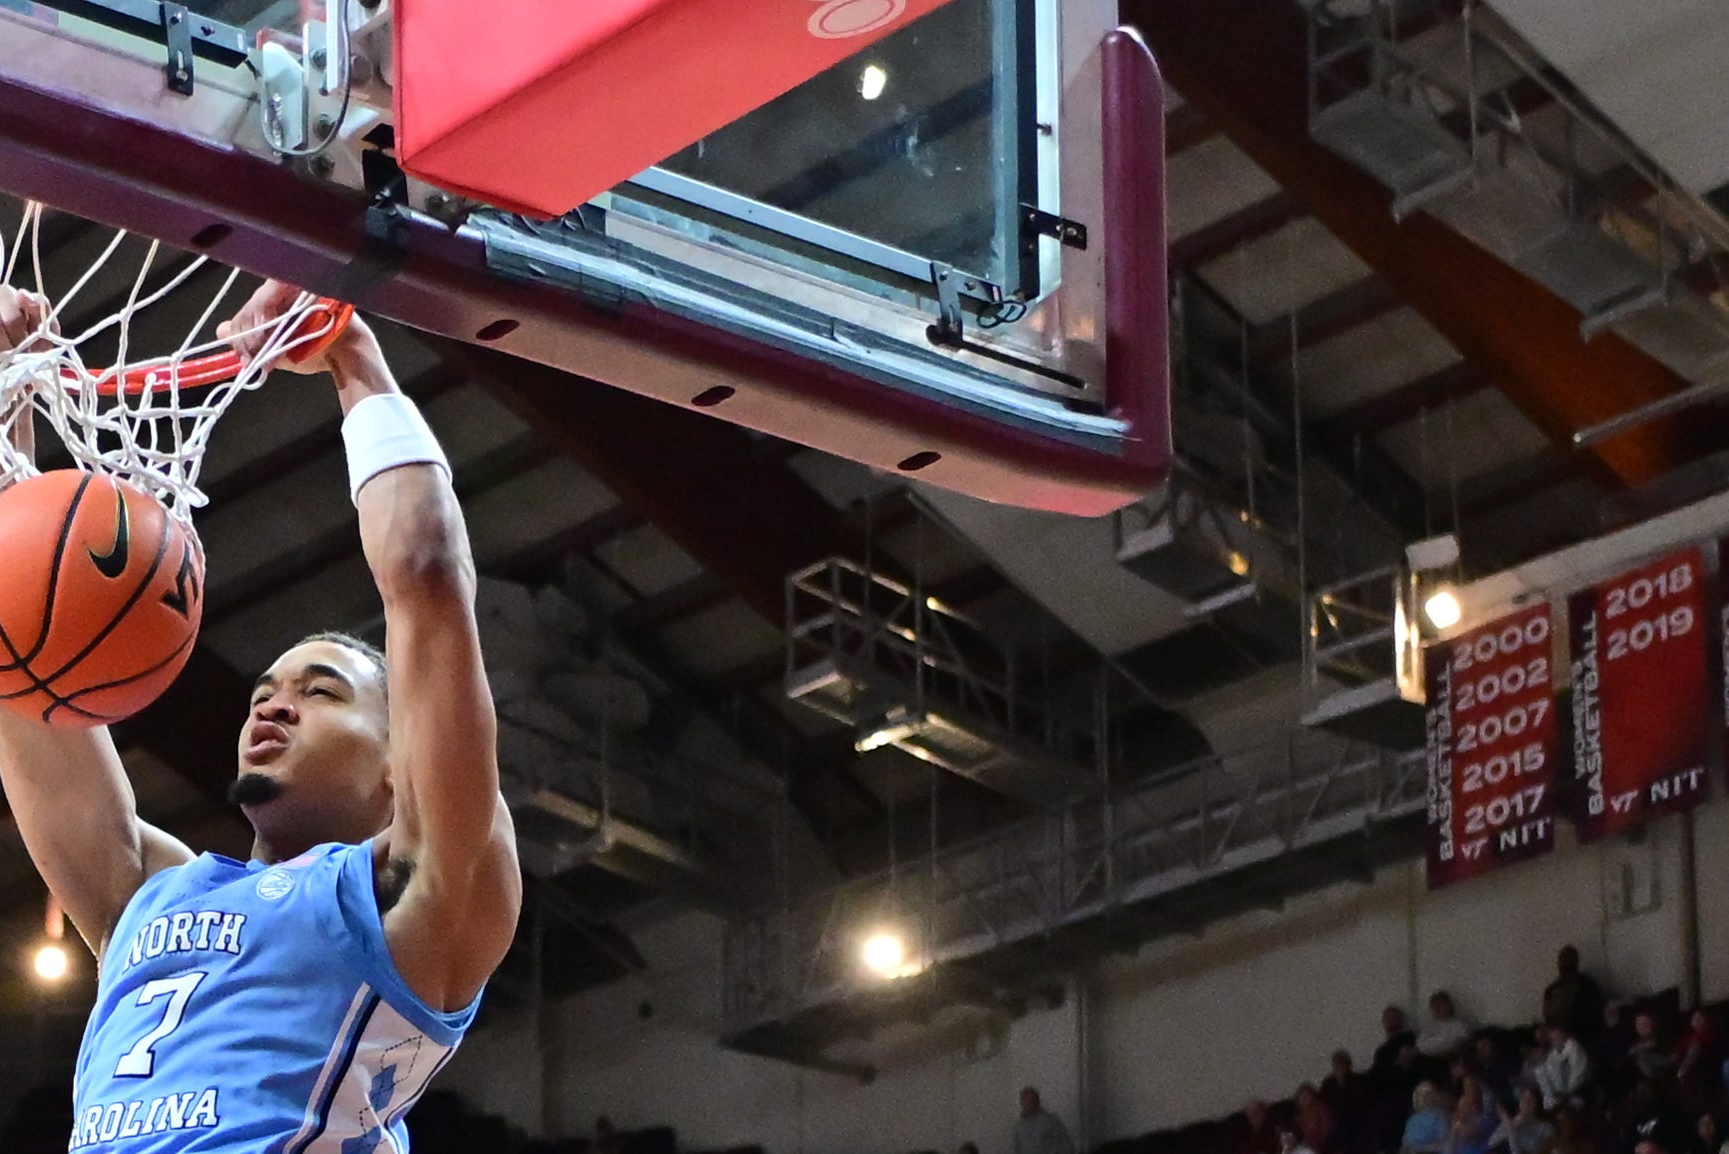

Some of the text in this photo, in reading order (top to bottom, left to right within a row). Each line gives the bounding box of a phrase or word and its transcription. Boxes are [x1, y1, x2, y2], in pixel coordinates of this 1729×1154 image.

[1605, 562, 1693, 620] 2018
[1452, 616, 1549, 672] 2000
[1607, 605, 1695, 661] 2019
[1455, 657, 1549, 712] 2002
[1582, 609, 1605, 816] BASKETBALL
[1457, 697, 1549, 751] 2007
[1436, 661, 1455, 862] BASKETBALL
[1462, 742, 1546, 793] 2015
[1650, 765, 1706, 804] NIT
[1465, 784, 1546, 834] 2017
[1498, 816, 1551, 851] NIT
[123, 909, 247, 972] NORTH
[112, 970, 209, 1079] 7
[67, 1085, 220, 1151] AROLINA
